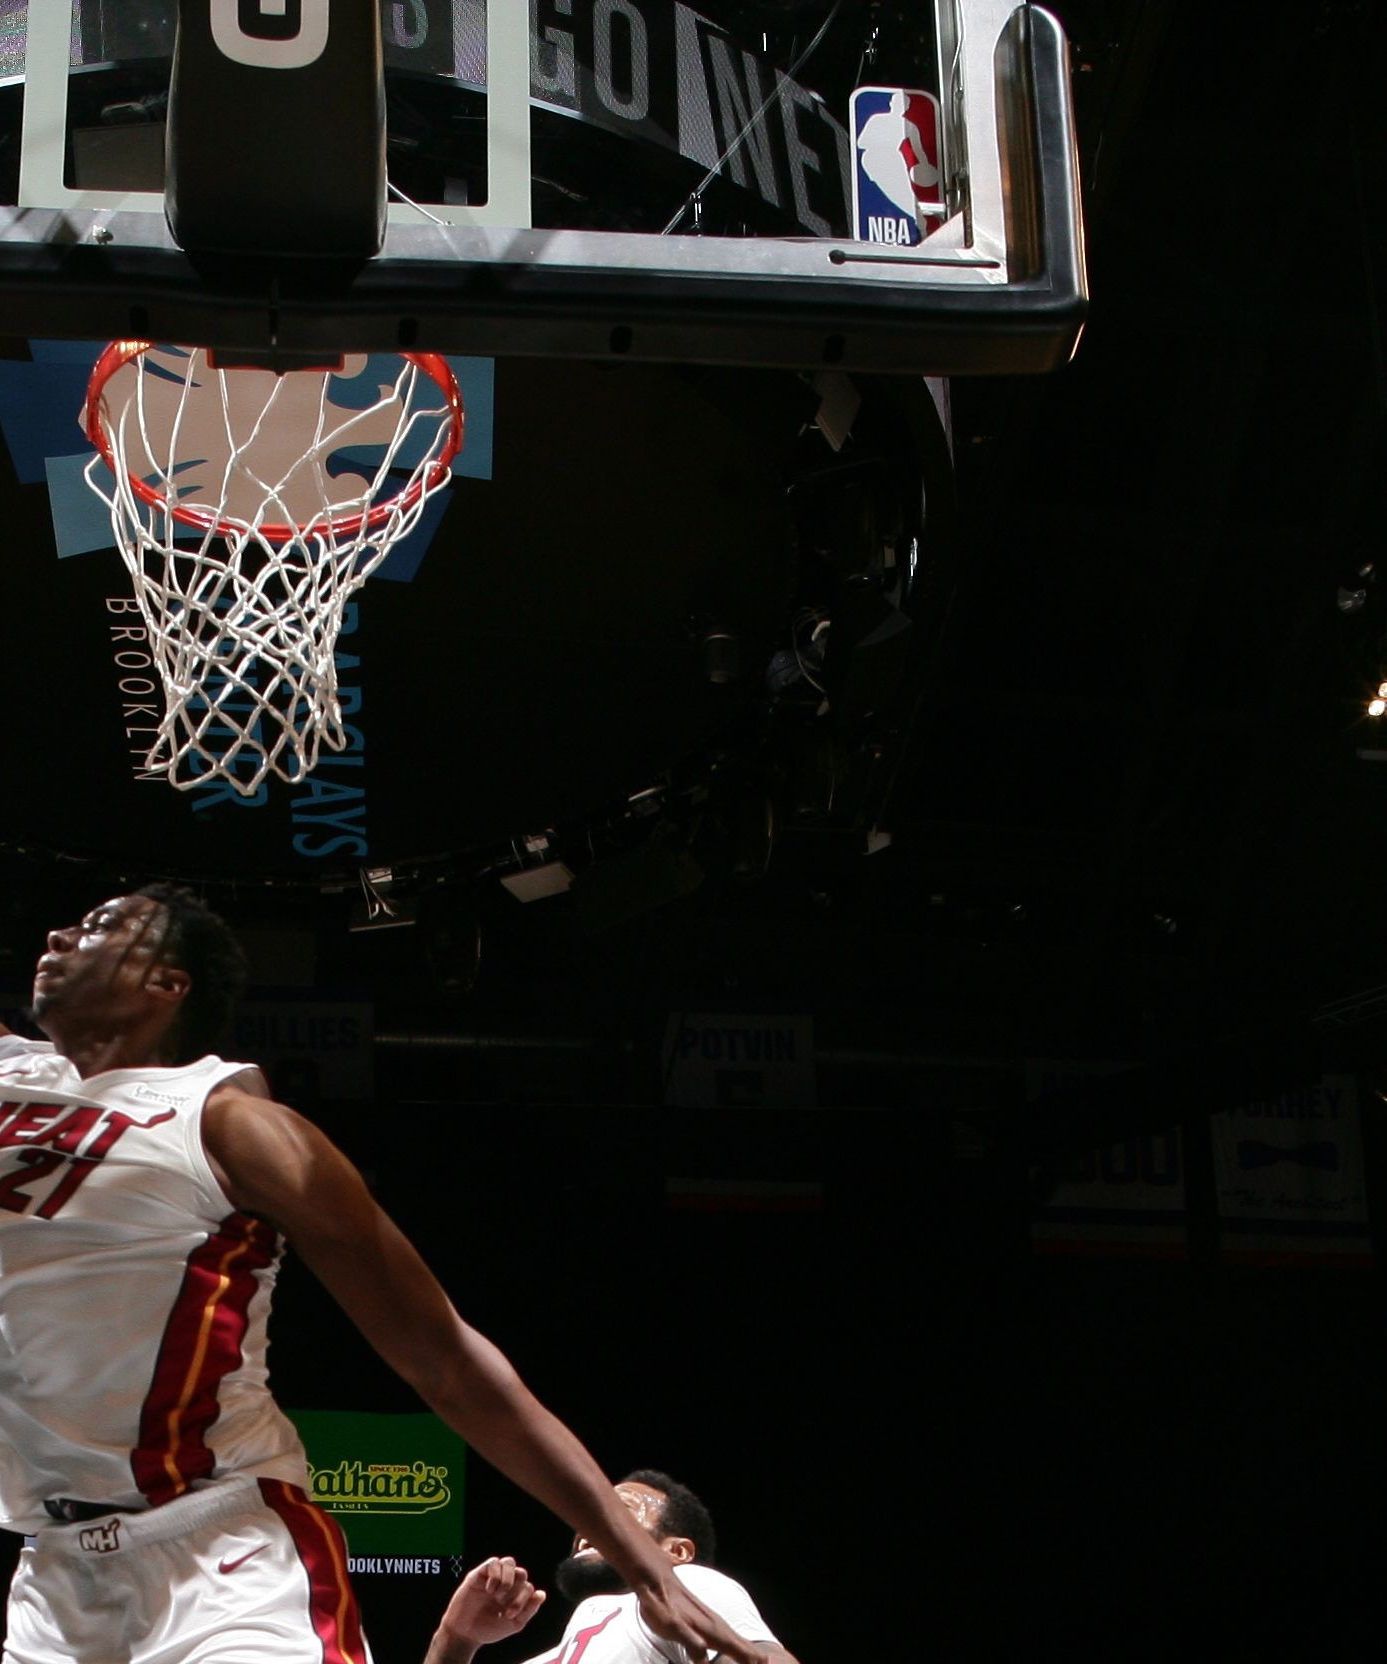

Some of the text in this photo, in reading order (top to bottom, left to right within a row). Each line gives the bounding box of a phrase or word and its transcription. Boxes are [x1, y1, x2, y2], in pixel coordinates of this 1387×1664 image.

[868, 216, 911, 244] NBA
[306, 1461, 443, 1499] athan's
[347, 1557, 441, 1575] OOKLYNNETS
